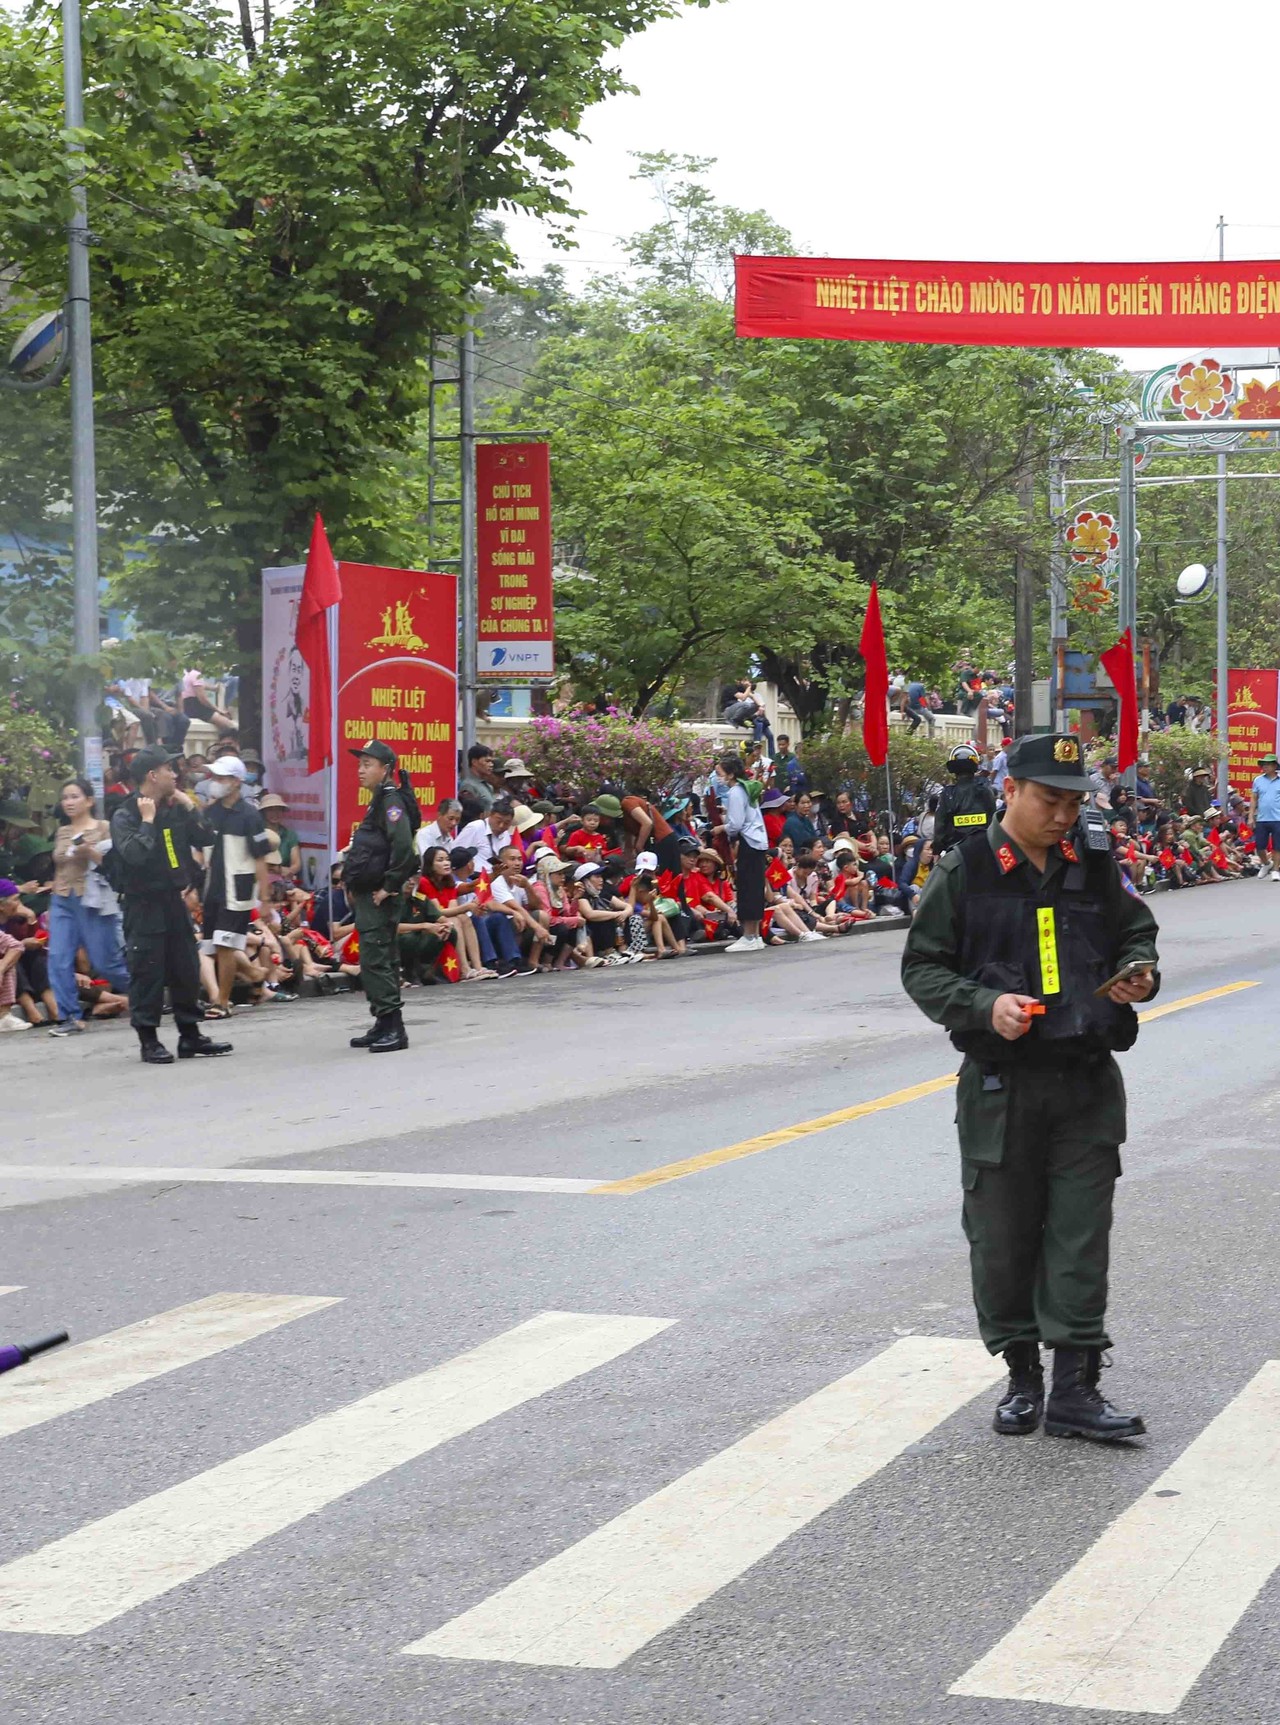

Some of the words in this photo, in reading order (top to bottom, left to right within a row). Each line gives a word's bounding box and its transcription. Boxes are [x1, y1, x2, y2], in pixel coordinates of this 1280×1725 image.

[816, 273, 868, 314] NHIỆT
[873, 275, 910, 316] LIỆT
[915, 275, 963, 313] CHÀO
[969, 275, 1025, 314] MỪNG
[1029, 282, 1053, 315] 70
[1057, 276, 1101, 315] NĂM
[1106, 275, 1162, 315] CHIẾN
[1169, 274, 1231, 315] THẮNG
[493, 480, 510, 499] CHỦ
[512, 484, 532, 501] TỊCH
[516, 506, 540, 521] MINH
[491, 547, 516, 566] SỐNG
[499, 574, 528, 588] TRONG
[505, 594, 537, 613] NGHIỆP
[480, 615, 499, 633] CỦA
[500, 616, 530, 633] CHÚNG
[509, 653, 539, 662] VNPT
[371, 685, 403, 712] NHIỆT
[404, 686, 426, 712] LIỆT
[345, 716, 374, 739] CHÀO
[377, 717, 409, 741] MỪNG
[411, 722, 424, 741] 70
[426, 719, 451, 742] NĂM
[398, 747, 433, 774] THẮNG
[414, 780, 436, 806] PHỦ
[1043, 916, 1054, 986] POLICE
